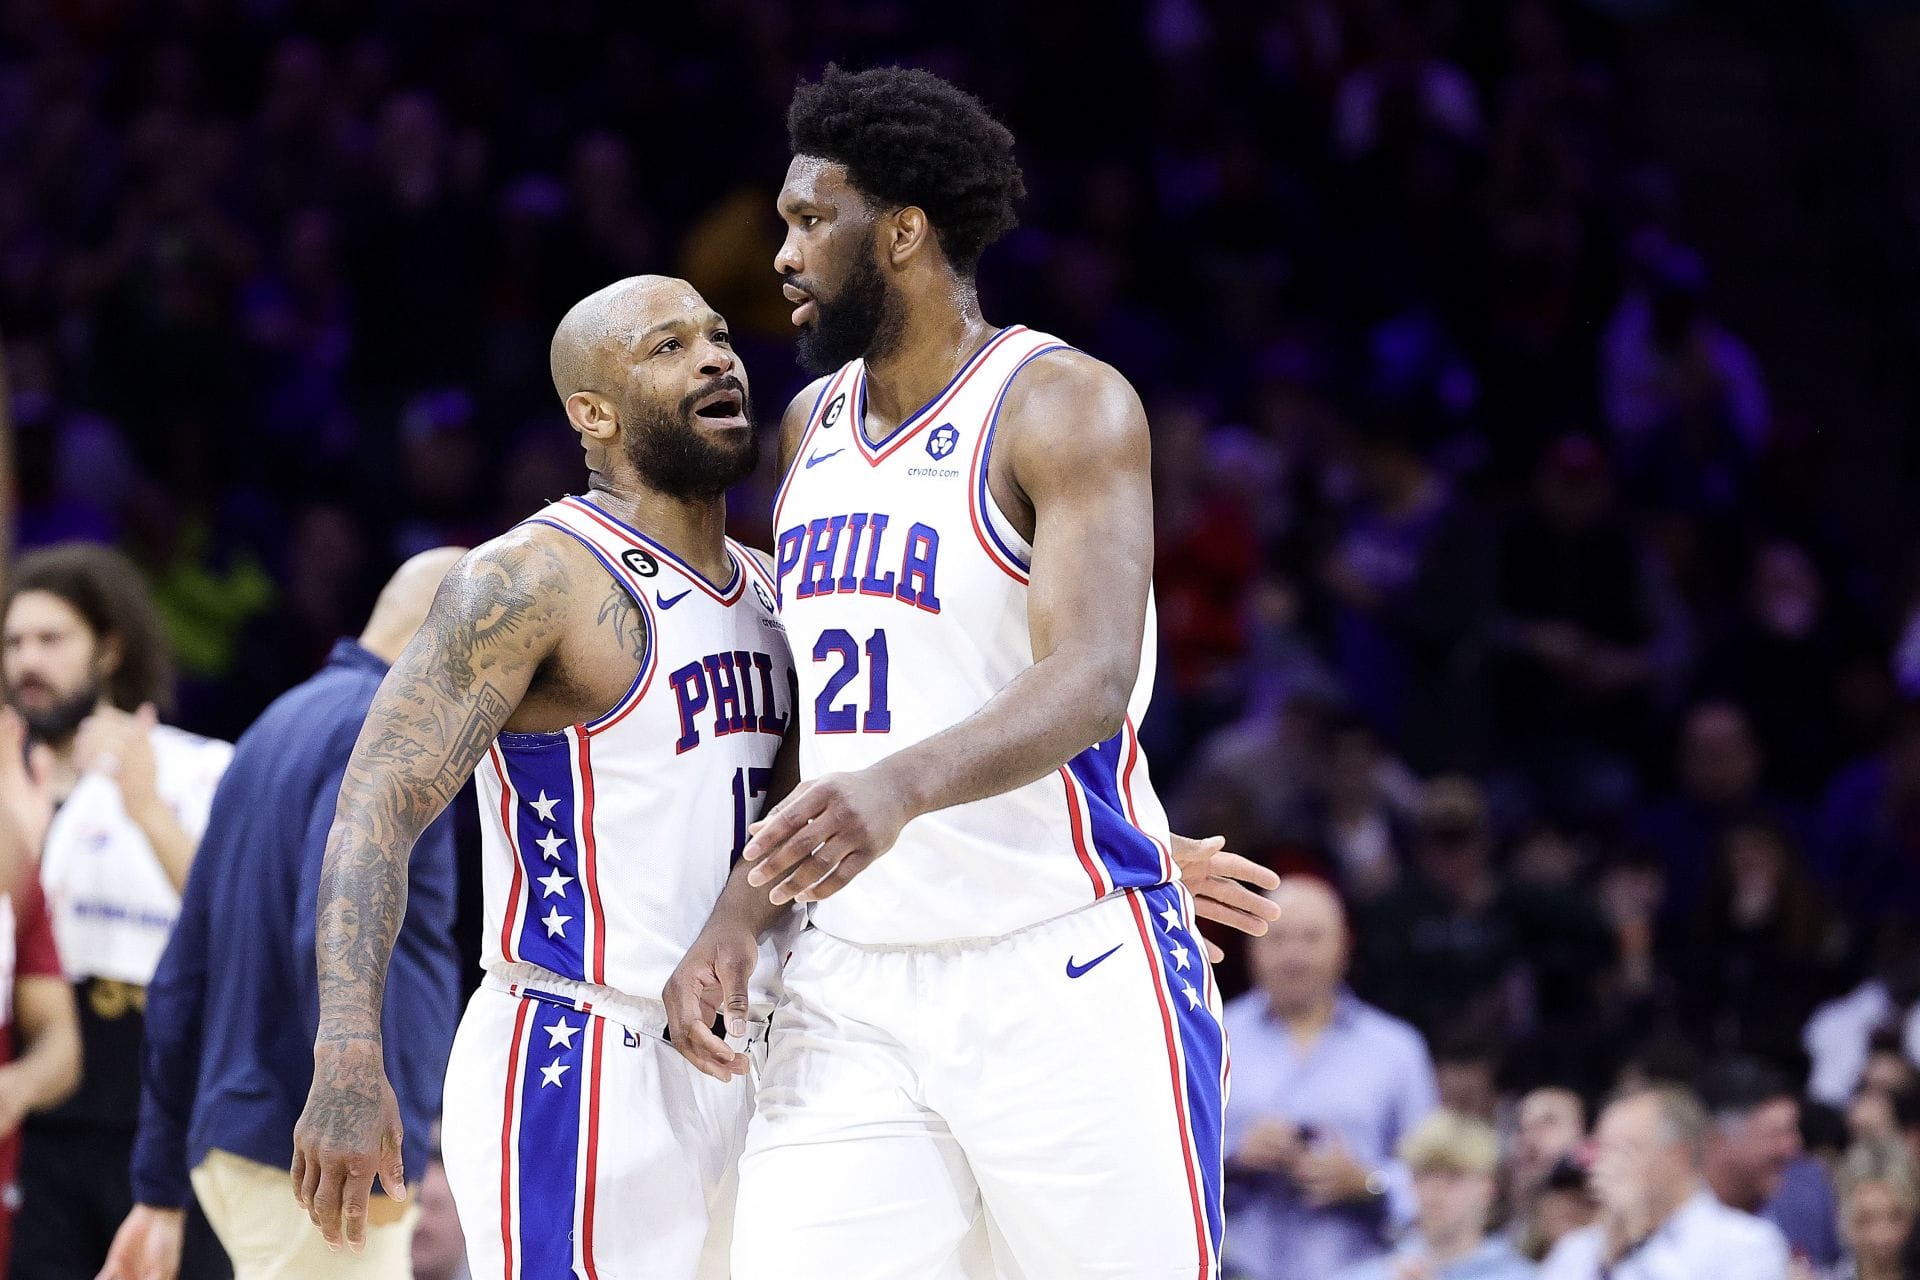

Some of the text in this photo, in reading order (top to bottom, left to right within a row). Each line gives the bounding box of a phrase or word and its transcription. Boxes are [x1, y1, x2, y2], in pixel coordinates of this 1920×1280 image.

[824, 395, 844, 426] 6
[625, 551, 655, 575] 6
[777, 513, 941, 614] PHILA
[669, 651, 800, 754] PHIL
[812, 629, 890, 734] 21
